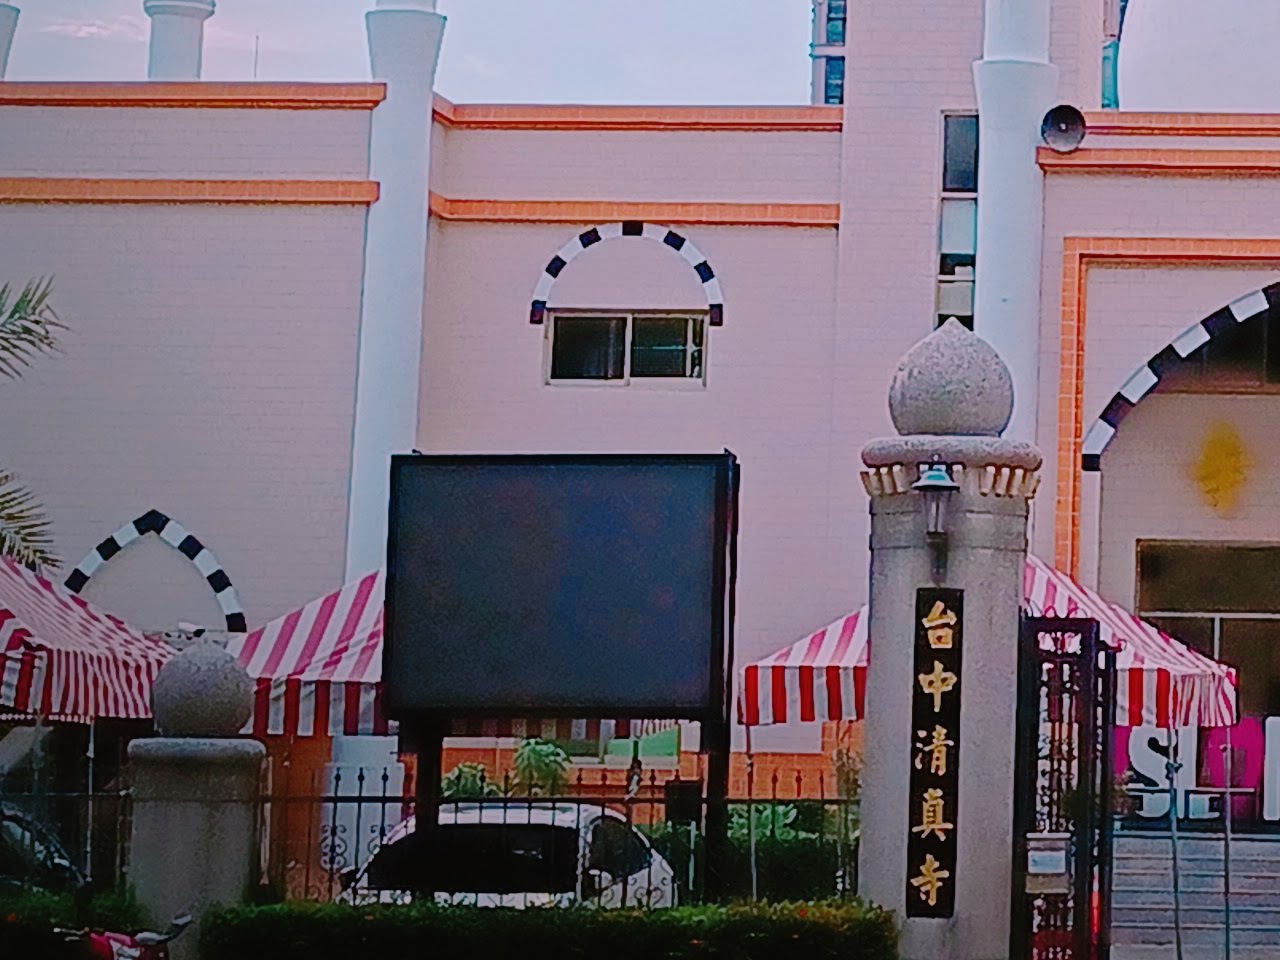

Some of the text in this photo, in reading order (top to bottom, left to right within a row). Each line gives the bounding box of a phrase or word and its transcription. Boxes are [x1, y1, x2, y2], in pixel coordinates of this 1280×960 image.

[910, 600, 958, 906] 台中清真寺
